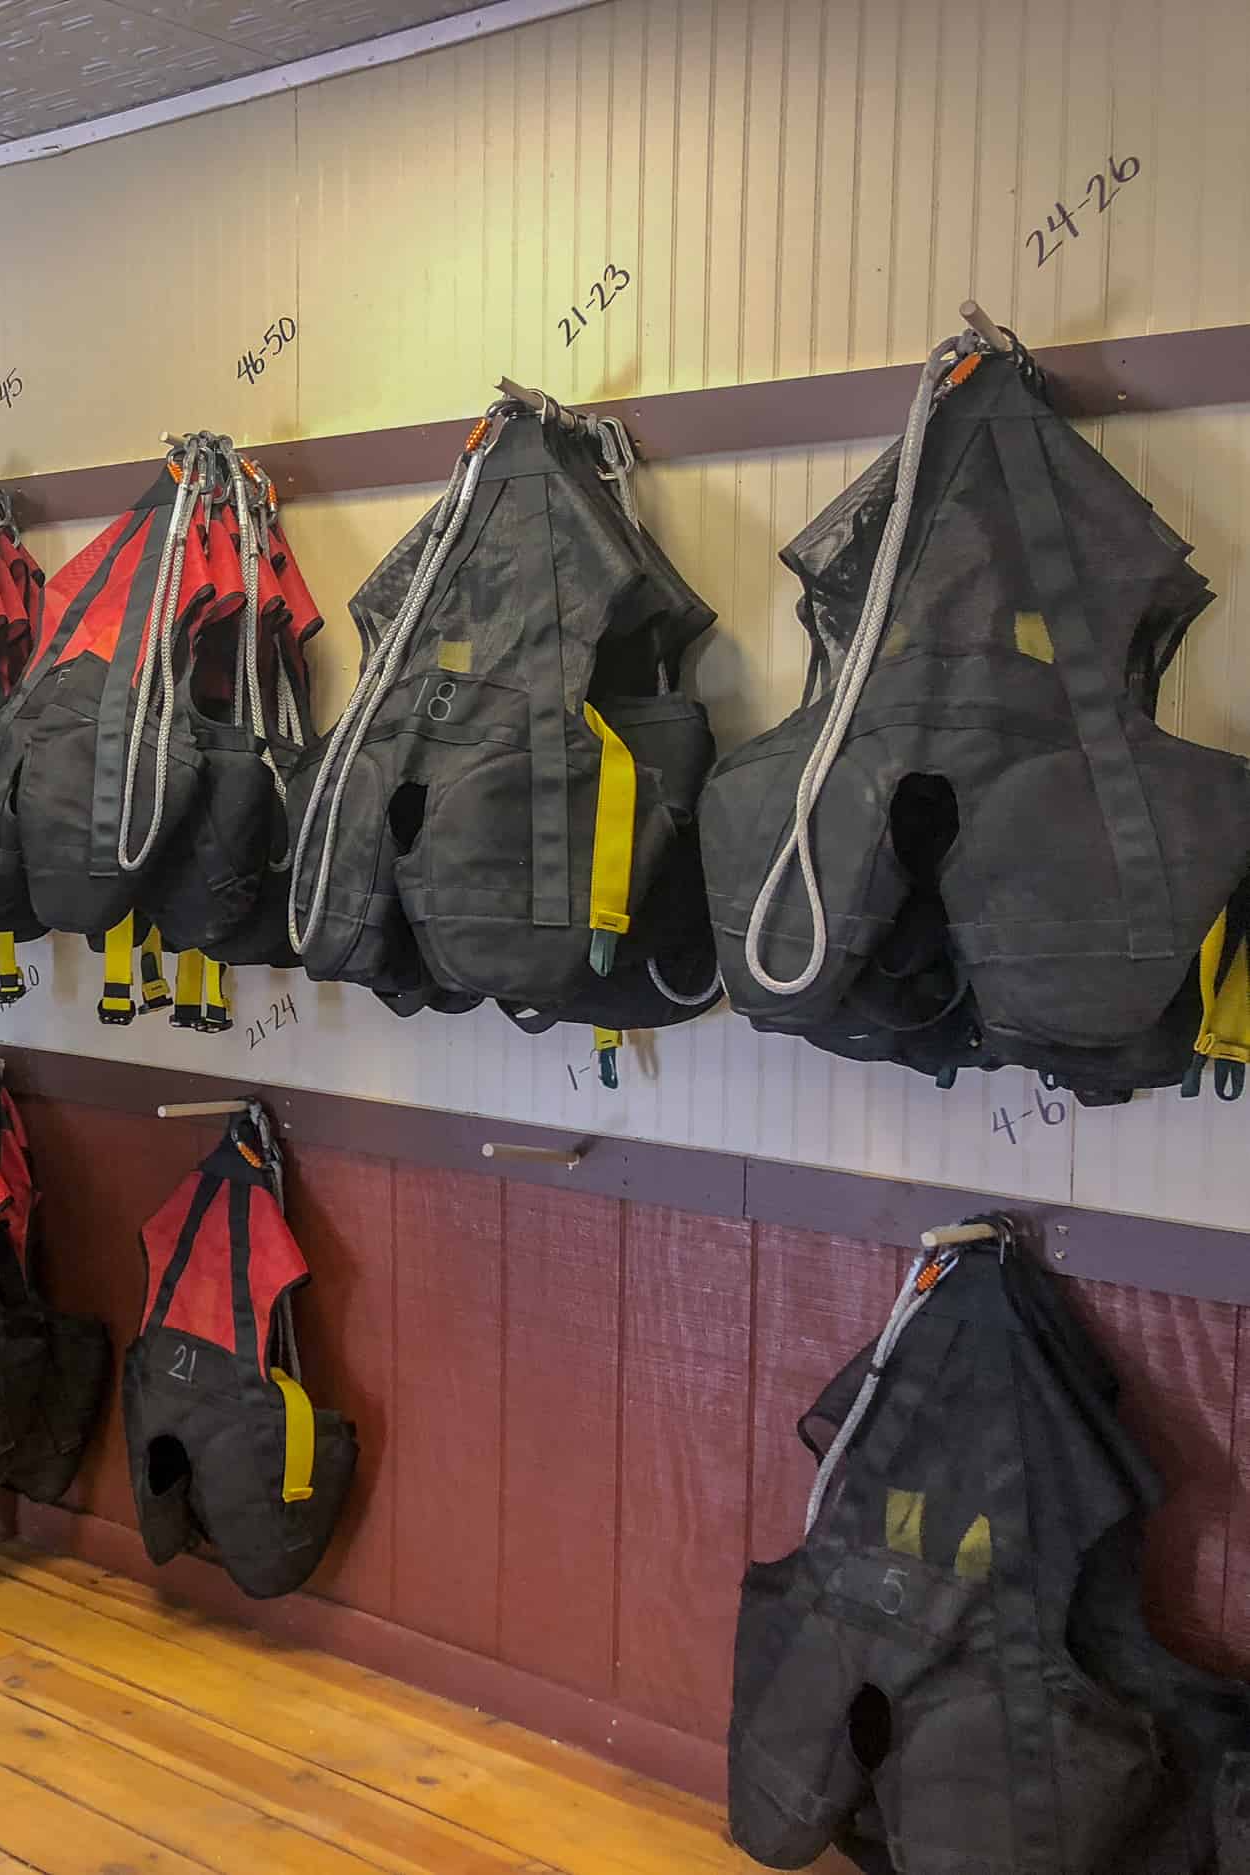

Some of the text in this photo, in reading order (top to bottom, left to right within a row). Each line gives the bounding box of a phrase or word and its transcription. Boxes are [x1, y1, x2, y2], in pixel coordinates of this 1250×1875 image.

[1025, 153, 1140, 267] 24-26
[557, 263, 631, 347] 21-23
[237, 316, 296, 385] 46-50
[413, 676, 456, 721] 18
[245, 993, 299, 1051] 21-24
[992, 1087, 1066, 1145] 4-6
[166, 1344, 197, 1383] 21
[875, 1567, 910, 1616] 5
